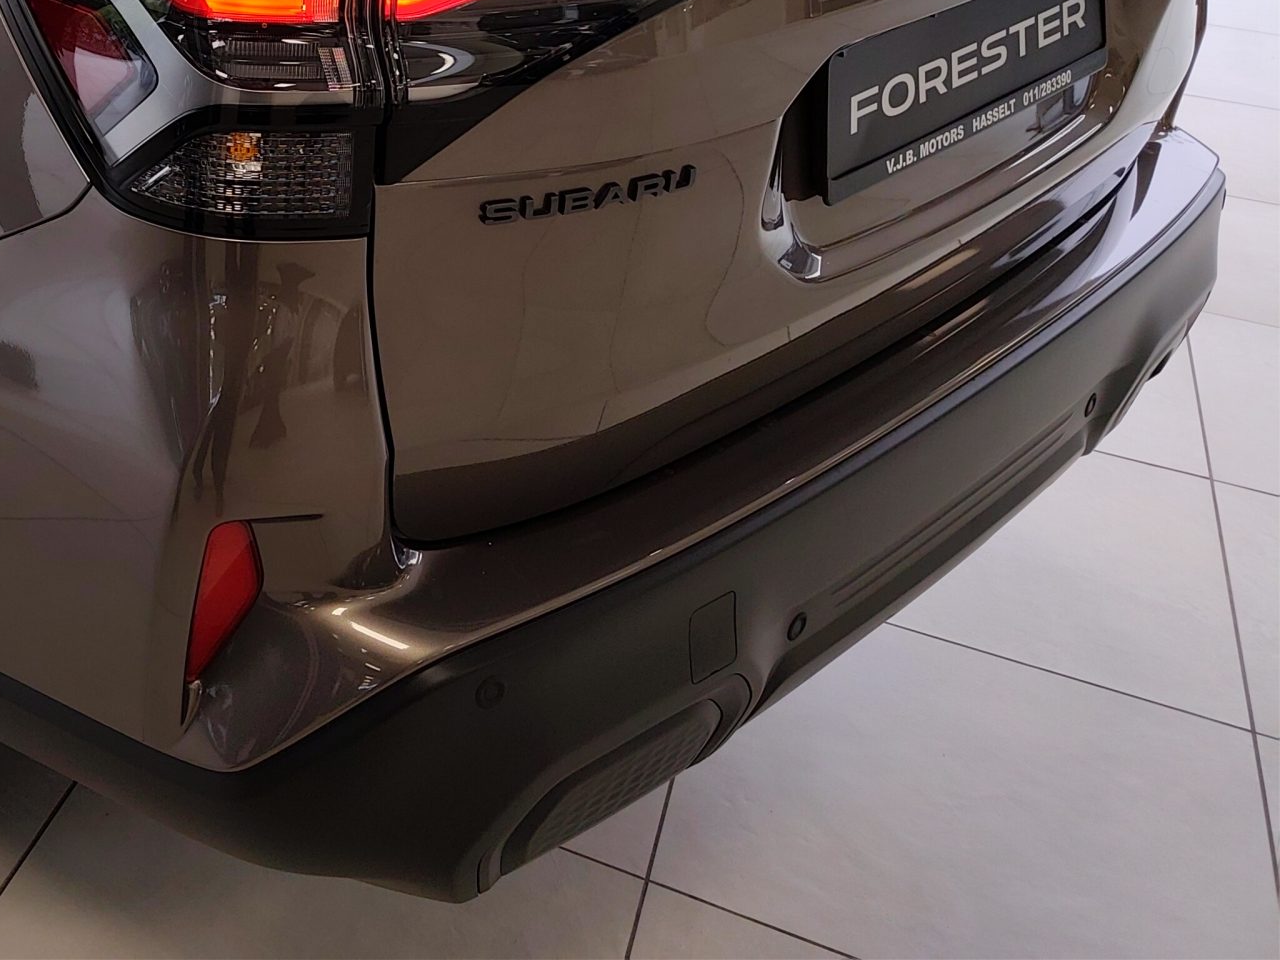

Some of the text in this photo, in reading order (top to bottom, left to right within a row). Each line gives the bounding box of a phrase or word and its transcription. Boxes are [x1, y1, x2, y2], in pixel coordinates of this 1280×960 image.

[886, 69, 1072, 175] V.J.B. MOTORS HASSELT 011/283390
[478, 163, 698, 226] SUBARU
